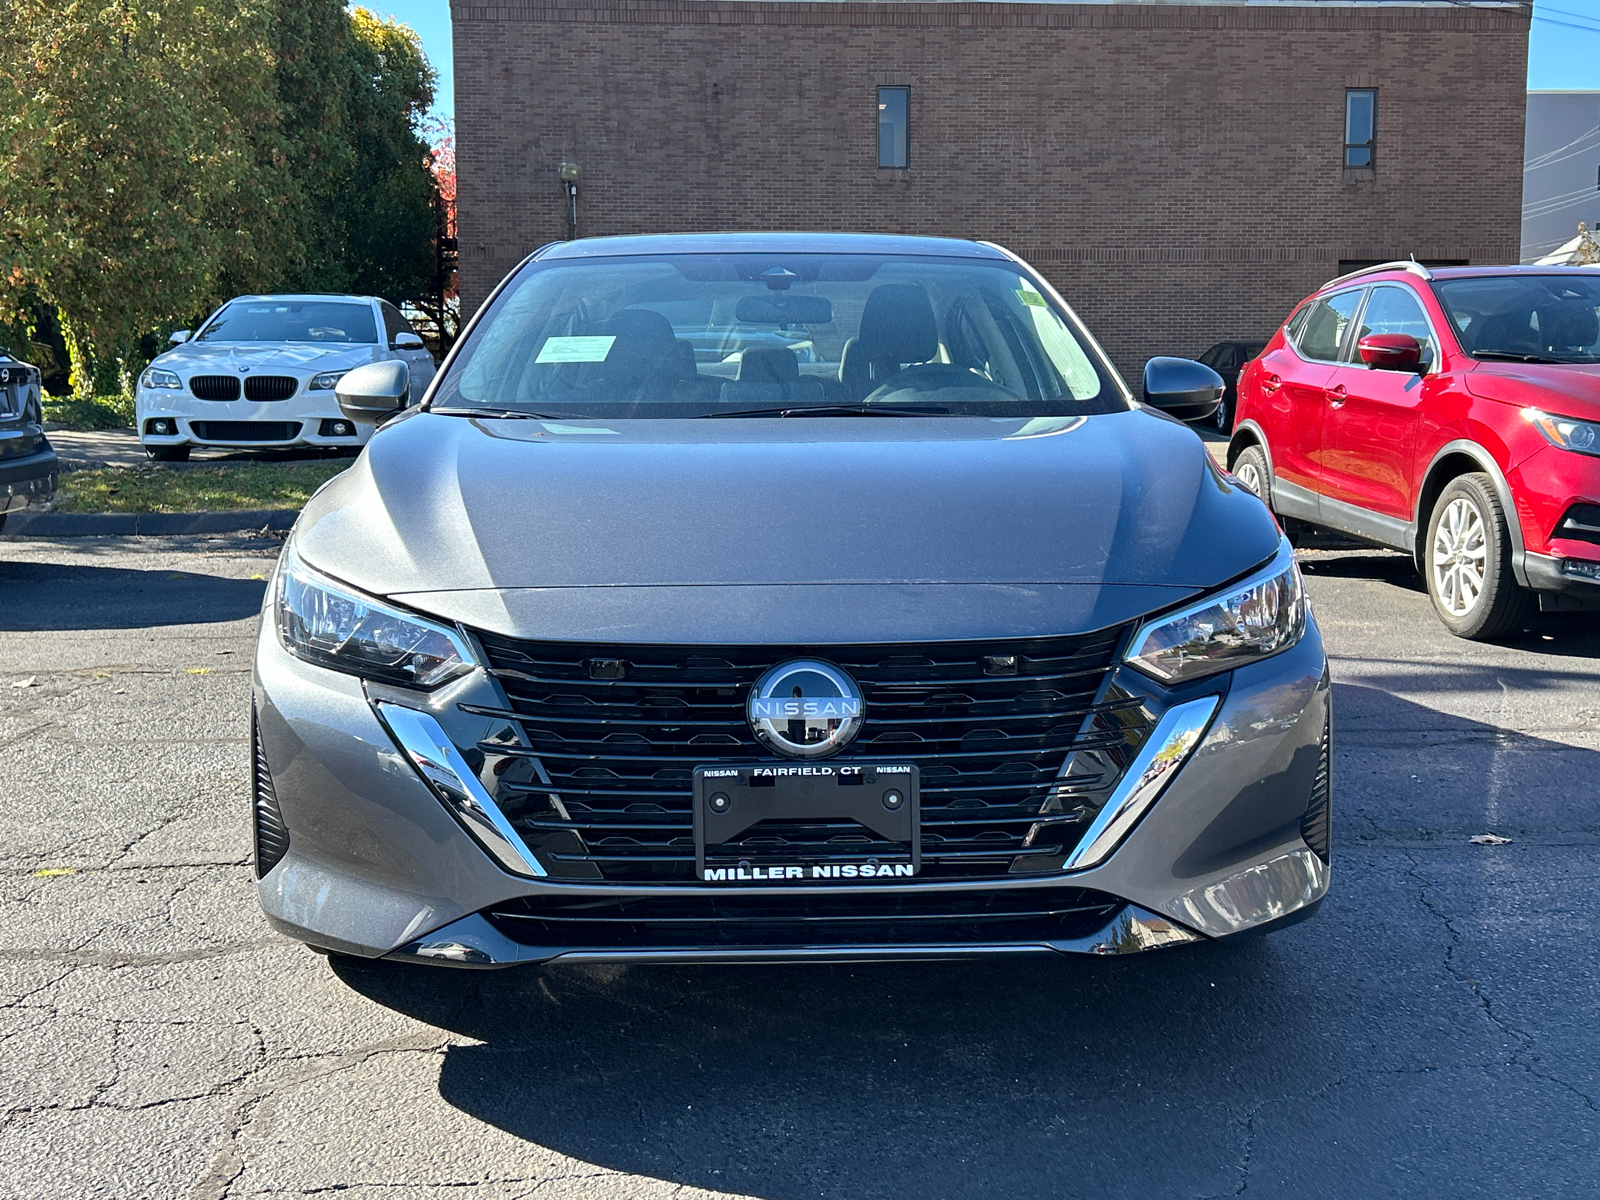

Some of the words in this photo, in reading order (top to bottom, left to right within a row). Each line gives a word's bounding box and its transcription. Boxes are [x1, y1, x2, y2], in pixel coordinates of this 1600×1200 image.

[756, 701, 857, 715] NISSAN
[753, 767, 836, 777] FAIRFIELD,
[840, 766, 861, 775] CT
[876, 766, 911, 774] NISSAN
[704, 866, 804, 881] MILLER
[812, 864, 914, 877] NISSAN
